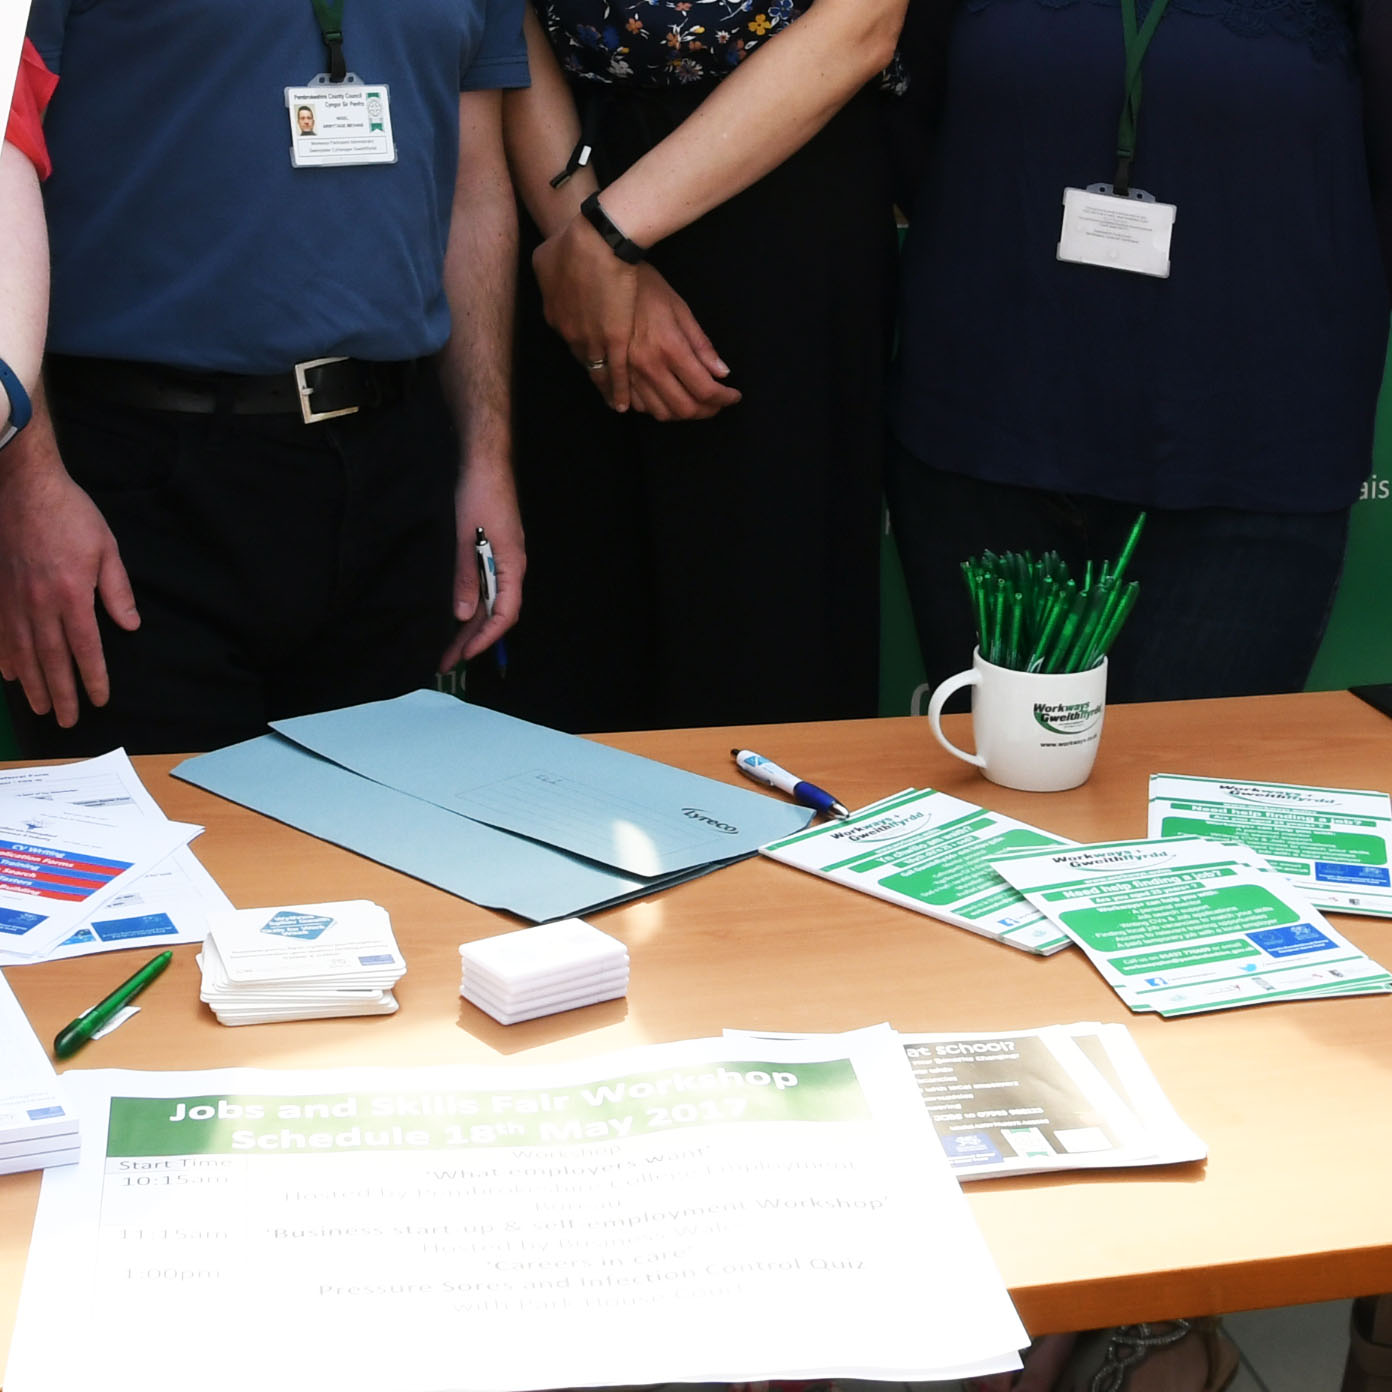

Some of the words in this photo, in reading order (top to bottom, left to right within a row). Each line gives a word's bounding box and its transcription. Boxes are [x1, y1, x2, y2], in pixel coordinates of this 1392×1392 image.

[682, 809, 738, 832] Lyreco
[1062, 887, 1100, 899] Need
[1102, 882, 1132, 894] help
[1132, 875, 1181, 889] finding
[906, 1047, 932, 1058] at
[936, 1040, 1016, 1056] school?
[169, 1100, 266, 1122] Jobs
[276, 1096, 357, 1119] and
[371, 1094, 480, 1117] Skills
[494, 1093, 570, 1114] Fair
[581, 1067, 799, 1107] Workshop
[231, 1126, 431, 1151] Schedule
[539, 1116, 634, 1142] May
[646, 1097, 748, 1128] 2017
[118, 1158, 178, 1171] Start
[179, 1157, 233, 1170] Time
